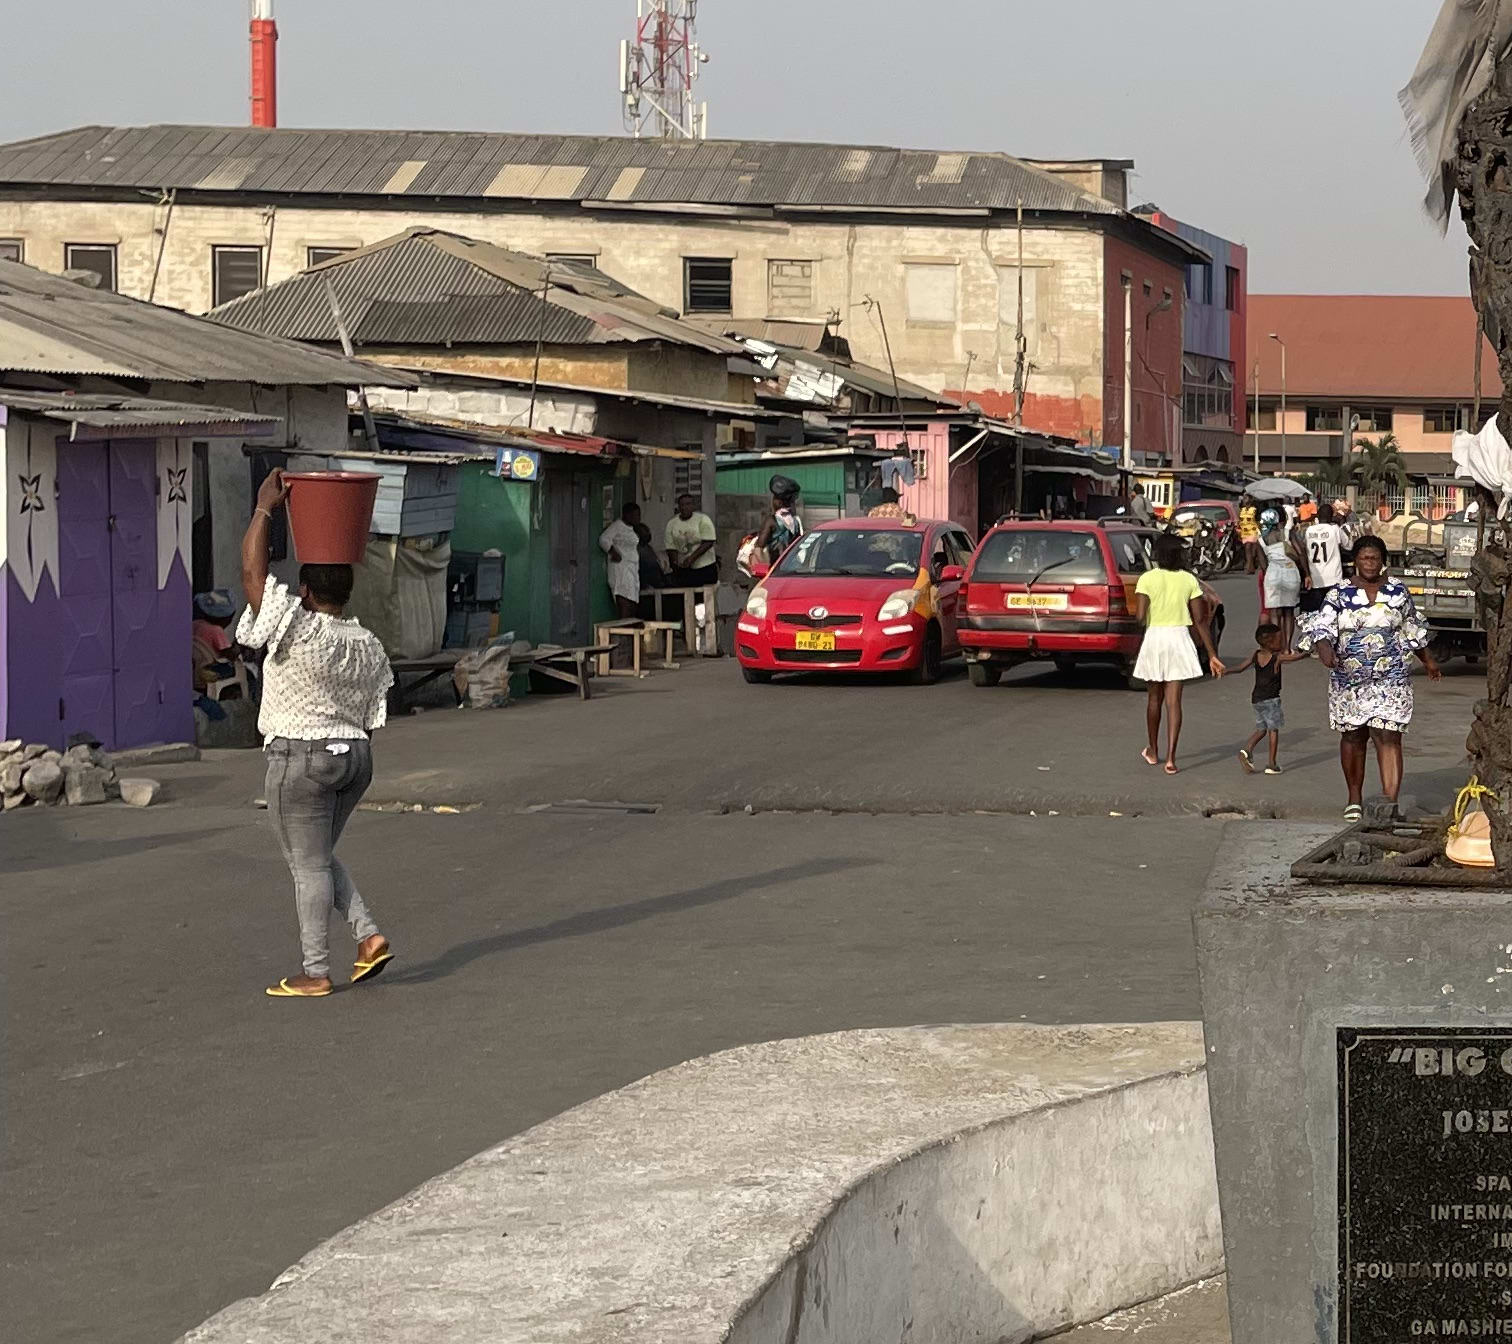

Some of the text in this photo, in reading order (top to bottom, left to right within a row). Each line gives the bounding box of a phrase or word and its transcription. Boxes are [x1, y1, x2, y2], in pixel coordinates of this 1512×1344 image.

[1311, 542, 1328, 563] 21
[1356, 1261, 1478, 1279] FOUNDATION
[1410, 1319, 1436, 1336] GA
[1442, 1318, 1512, 1336] MASHIE
